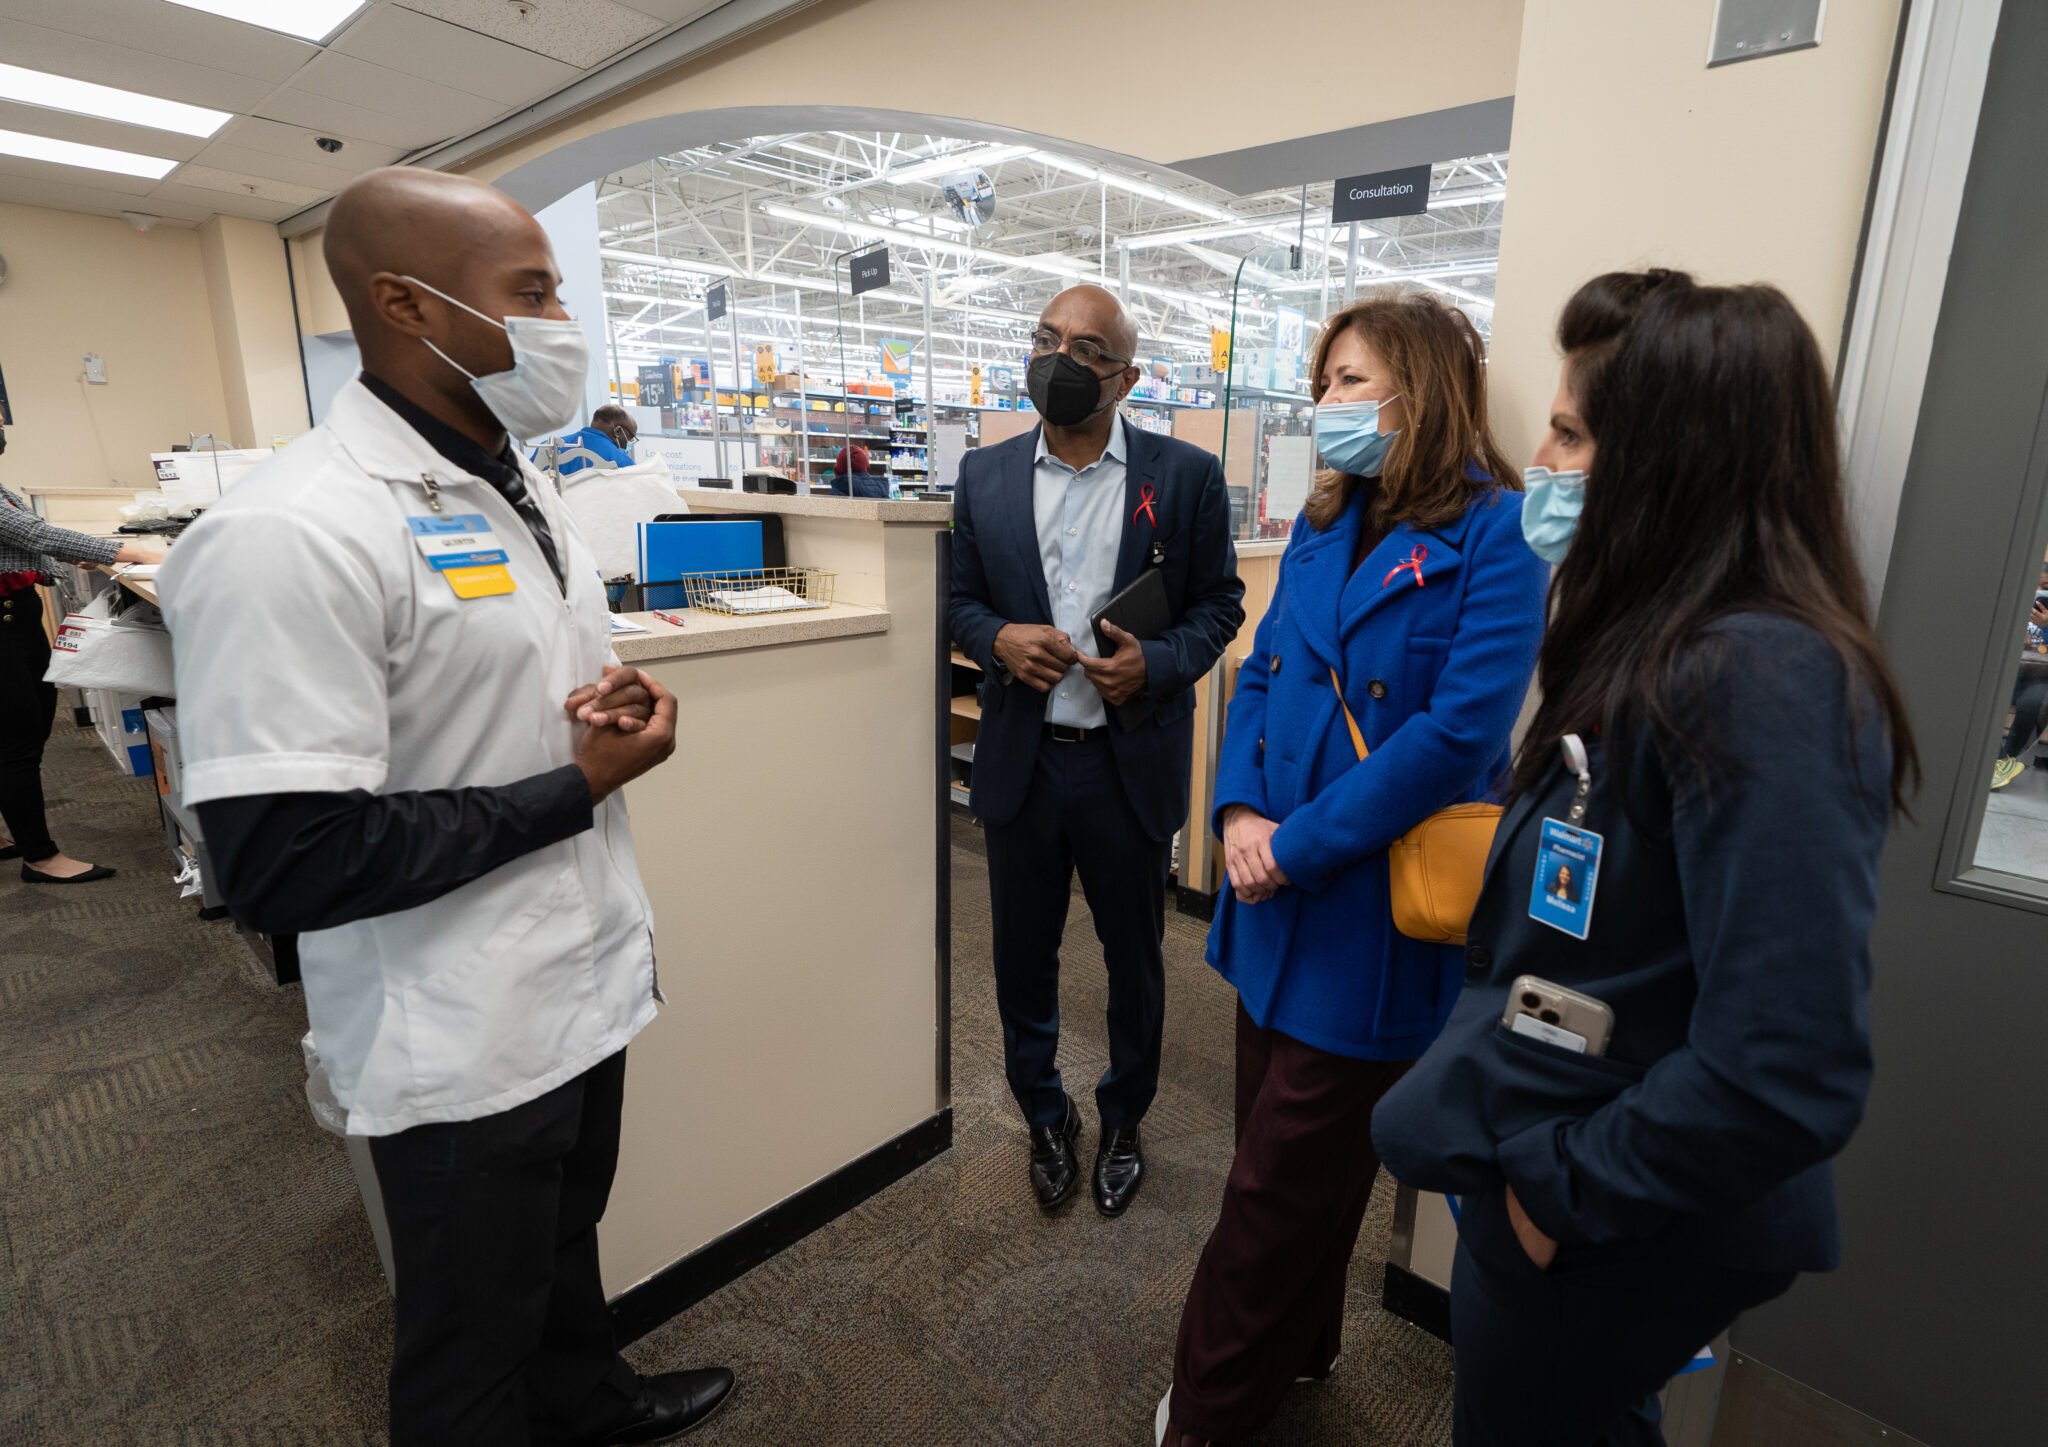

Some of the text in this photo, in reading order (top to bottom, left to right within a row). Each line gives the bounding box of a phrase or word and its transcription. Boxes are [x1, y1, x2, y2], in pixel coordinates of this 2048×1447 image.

[1349, 183, 1413, 200] Consultation
[861, 266, 878, 279] Pick Up
[1220, 350, 1228, 358] A
[1221, 360, 1226, 369] 5
[57, 640, 79, 649] 1194
[1549, 826, 1582, 846] Walmart
